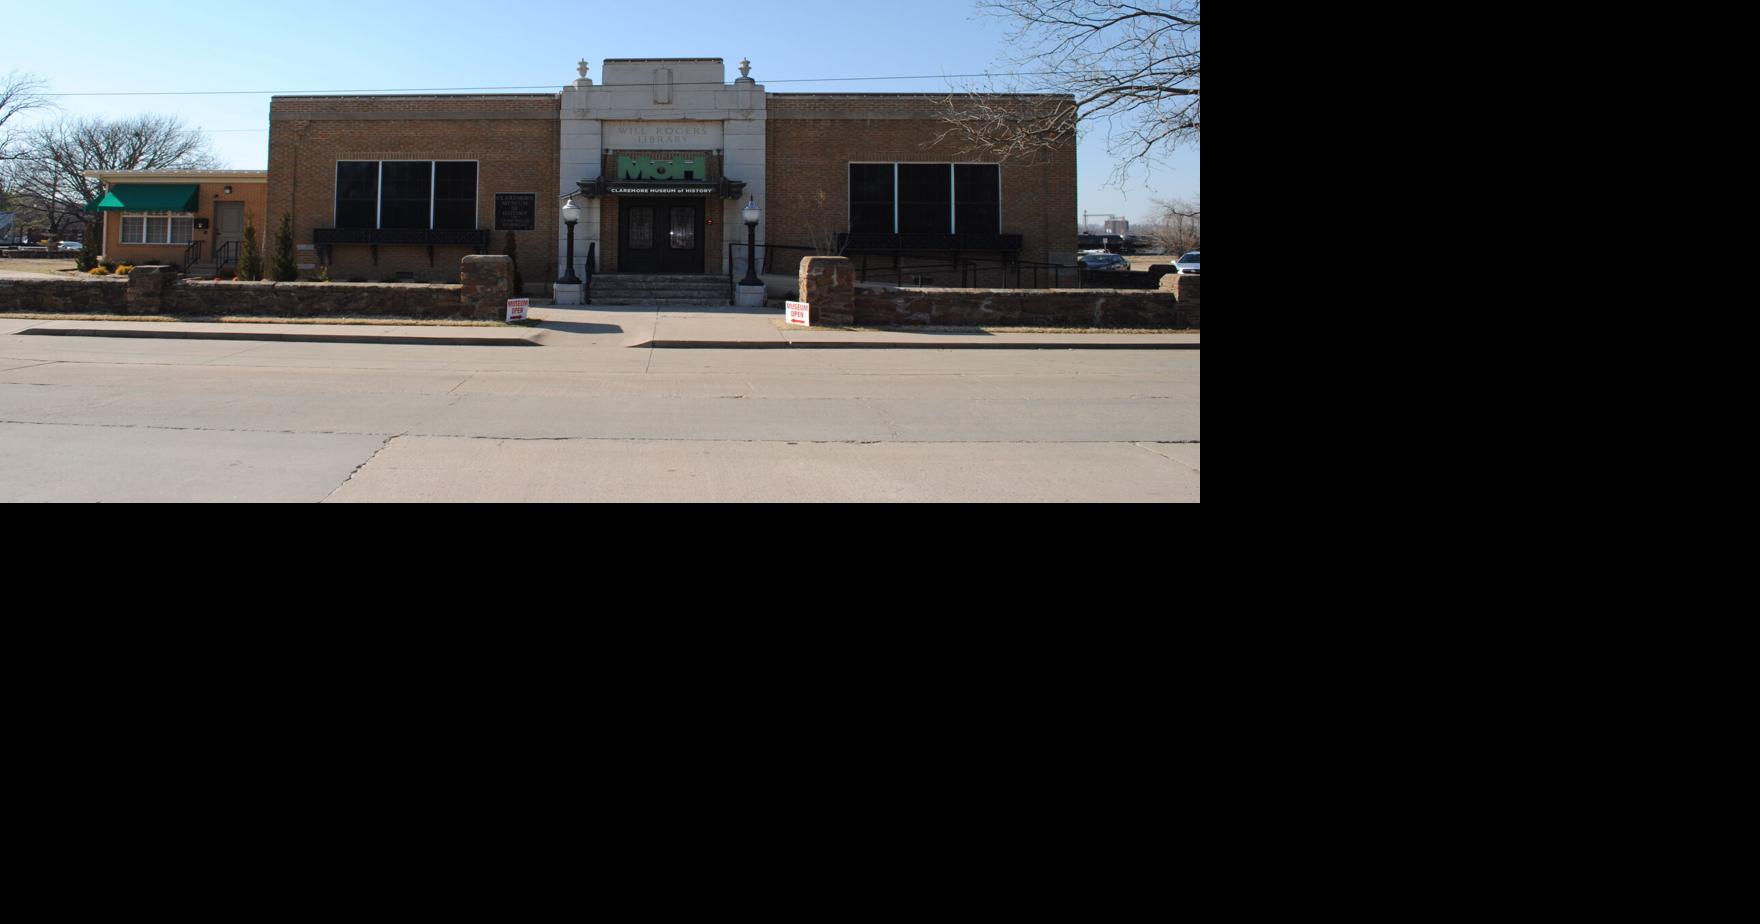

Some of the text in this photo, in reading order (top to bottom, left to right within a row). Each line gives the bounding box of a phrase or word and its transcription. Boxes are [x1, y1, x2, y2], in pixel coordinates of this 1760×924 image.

[618, 127, 707, 136] WILL ROGERS
[638, 136, 687, 144] LIBRARY
[787, 303, 809, 311] MUSEUM
[791, 310, 804, 318] OPEN
